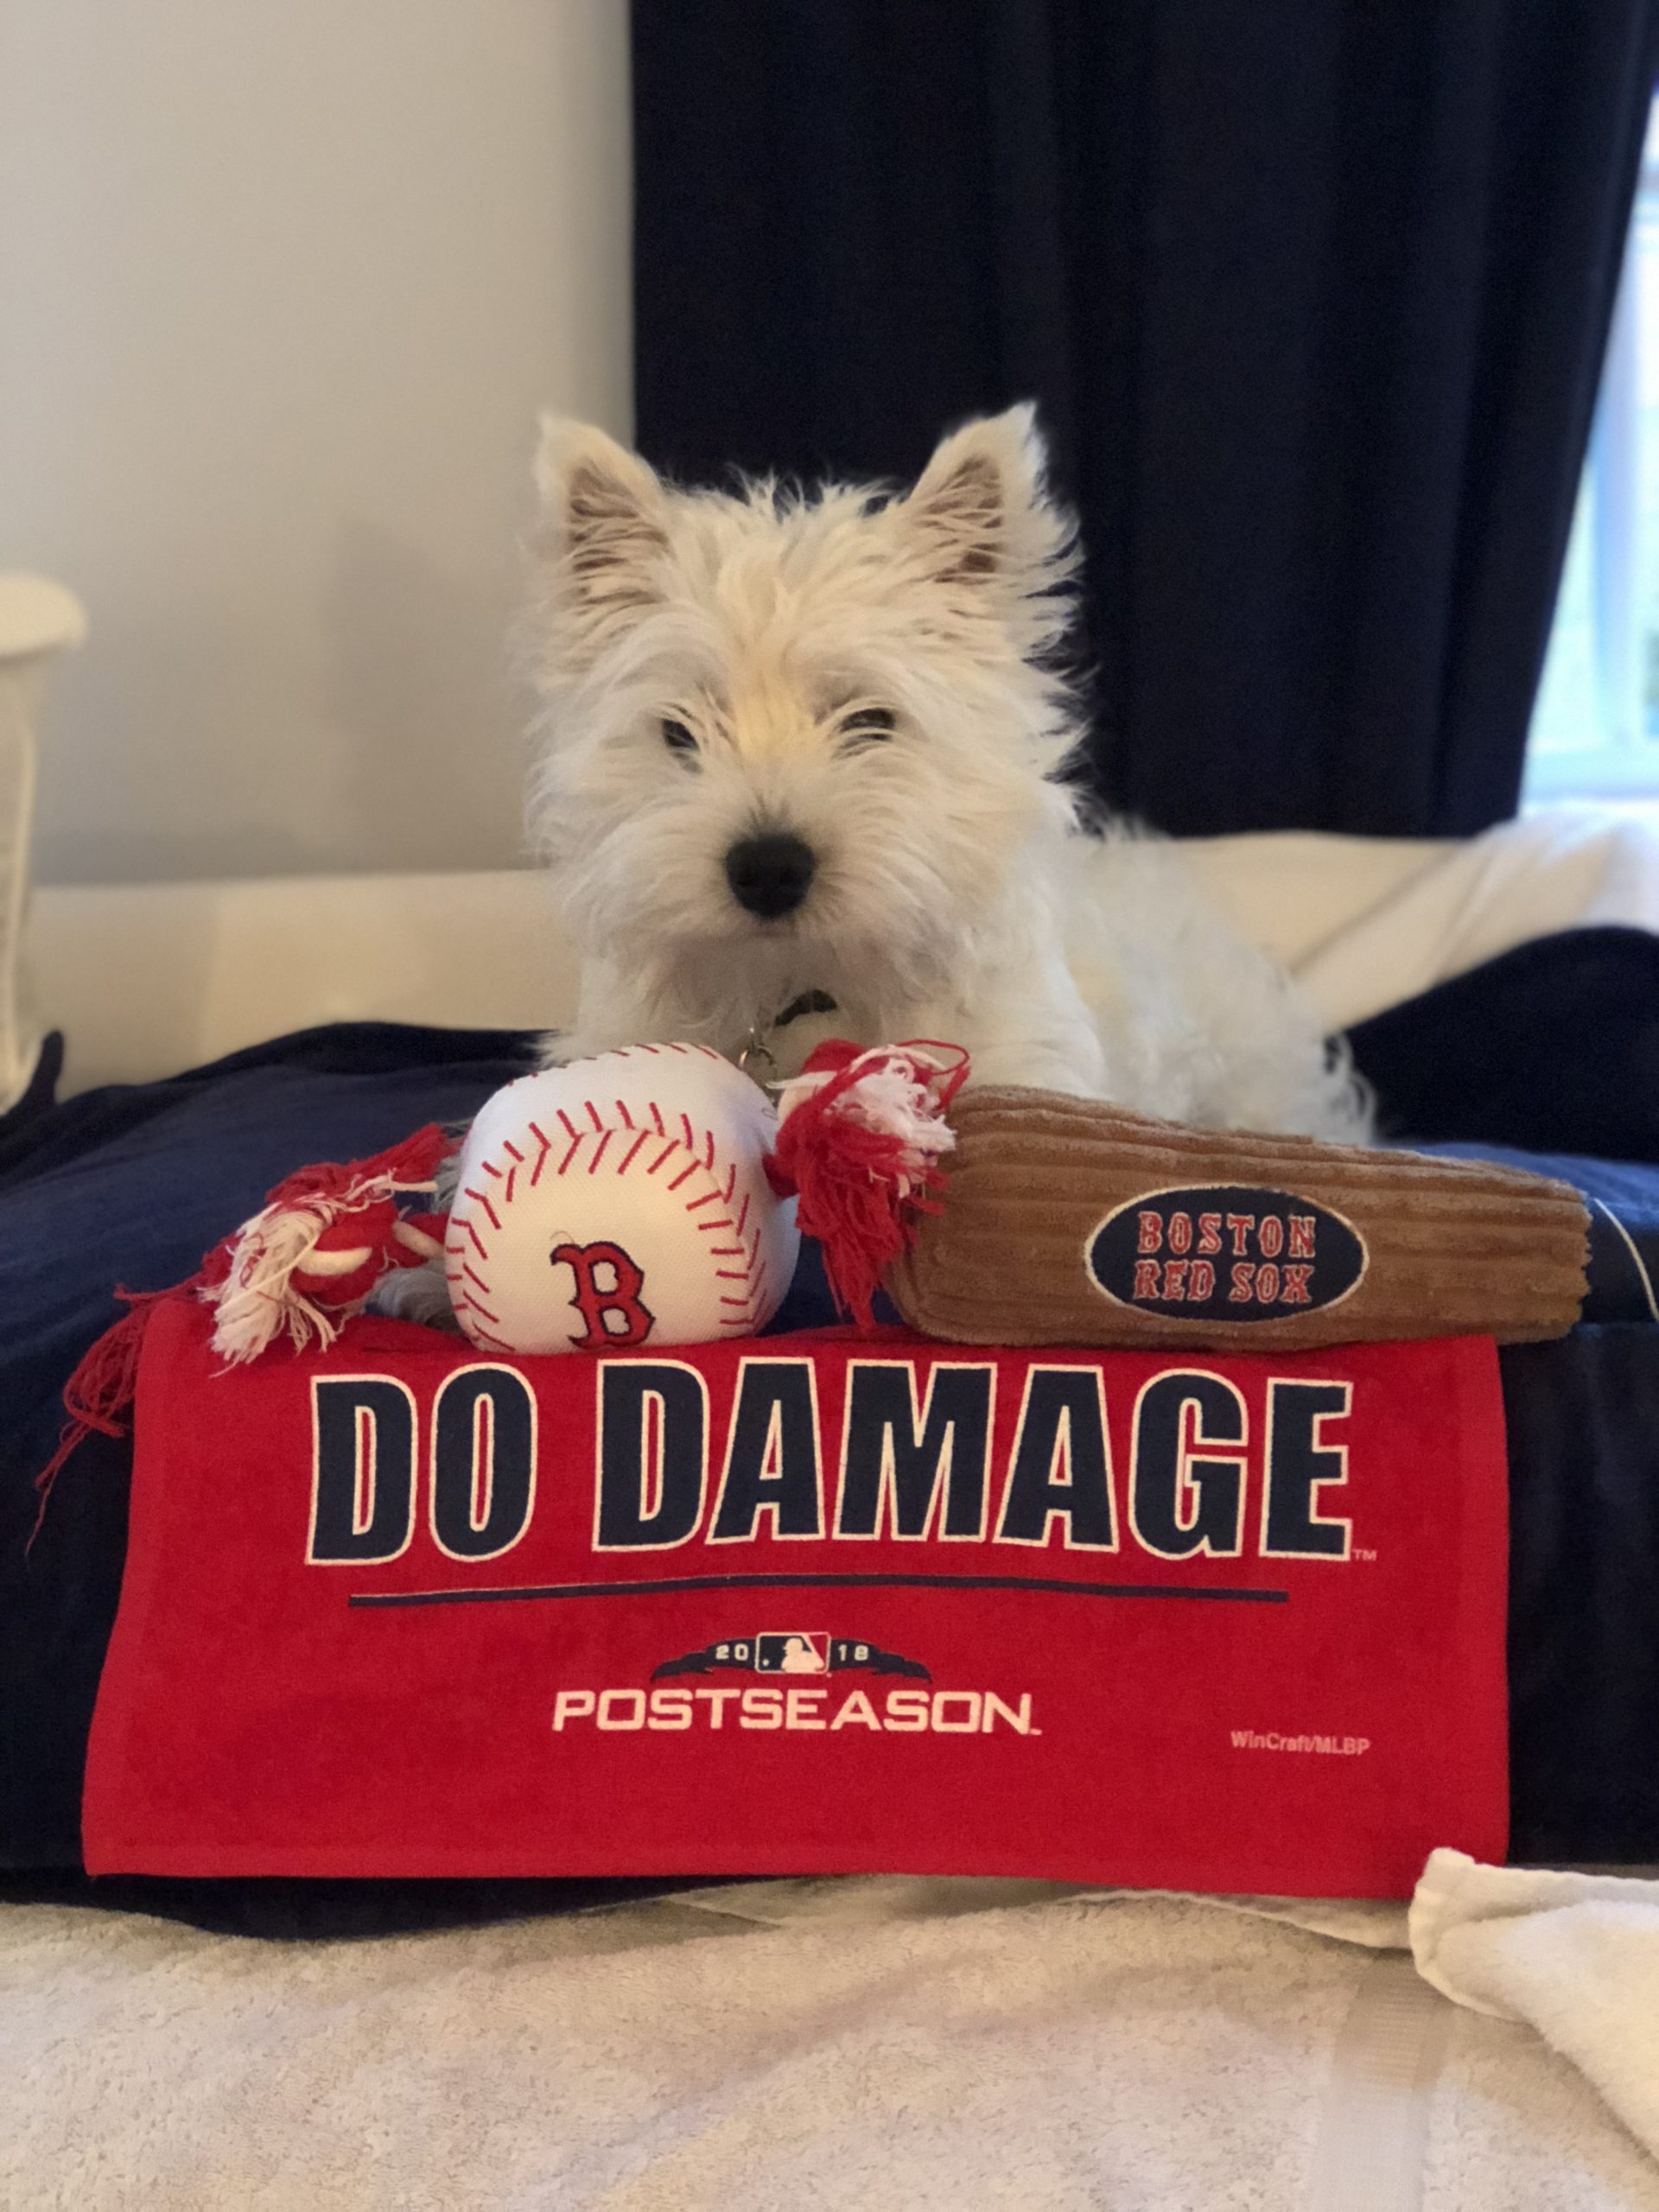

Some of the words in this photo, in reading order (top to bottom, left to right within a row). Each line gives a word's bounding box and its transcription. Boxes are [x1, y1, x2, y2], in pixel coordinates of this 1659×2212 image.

[1137, 1211, 1316, 1257] BOSTON
[550, 1241, 657, 1349] B
[1133, 1258, 1216, 1302] RED
[1229, 1262, 1316, 1304] SOX
[305, 1362, 538, 1566] DO
[592, 1356, 1353, 1561] DAMAGE
[715, 1643, 749, 1661] 20
[838, 1643, 869, 1661] 18
[552, 1688, 1032, 1735] POSTSEASON
[1230, 1731, 1370, 1755] WinCraft/MLBP
